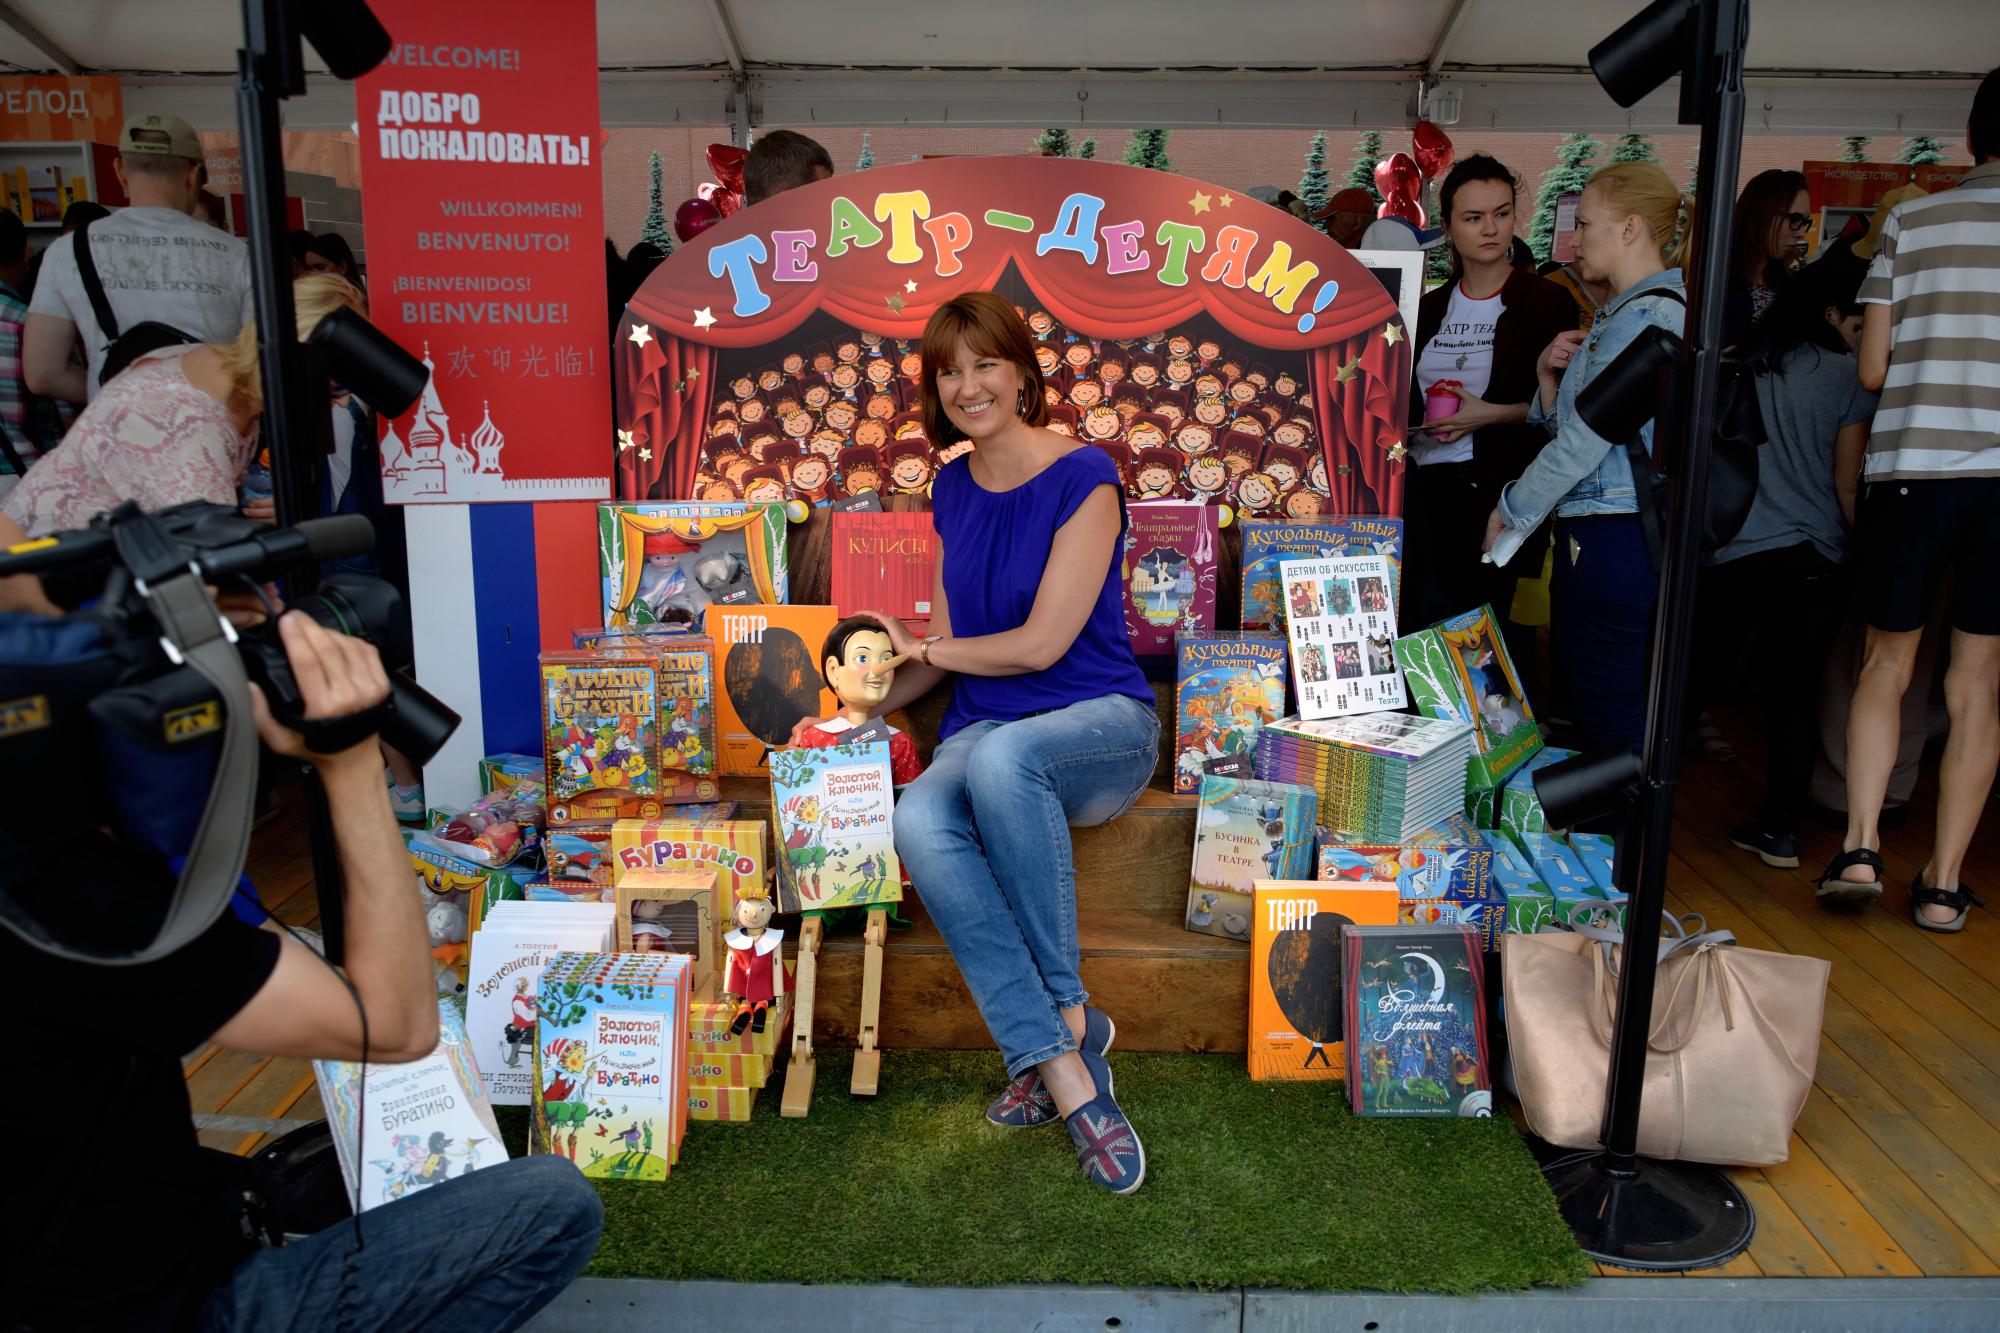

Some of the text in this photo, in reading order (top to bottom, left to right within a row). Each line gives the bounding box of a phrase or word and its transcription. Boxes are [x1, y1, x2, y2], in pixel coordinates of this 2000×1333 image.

[0, 90, 89, 118] ЕЛОД
[378, 90, 480, 126] ДОБРО
[379, 128, 590, 166] ПОЖАЛОВАТЬ!
[440, 201, 582, 218] WILLKOMMEN!
[417, 232, 570, 251] BENVENUTO!
[708, 190, 972, 317] ТЕАТР
[1036, 193, 1339, 333] ДЕТЯМ!
[402, 302, 569, 324] BIENVENUE!
[1134, 521, 1196, 538] Театральные
[1148, 534, 1182, 543] сказки
[848, 537, 930, 555] КУЛИСЫ
[1287, 562, 1381, 578] ДЕТЯМ ОБ ИСКУССТВЕ
[722, 615, 767, 643] ТЕАТР
[1378, 697, 1400, 705] Театр
[1215, 831, 1261, 847] БУСИНКА
[1233, 845, 1240, 854] В
[1216, 854, 1254, 867] ТЕАТРЕ
[1266, 899, 1318, 931] ТЕАТР
[1374, 1013, 1442, 1042] флейта
